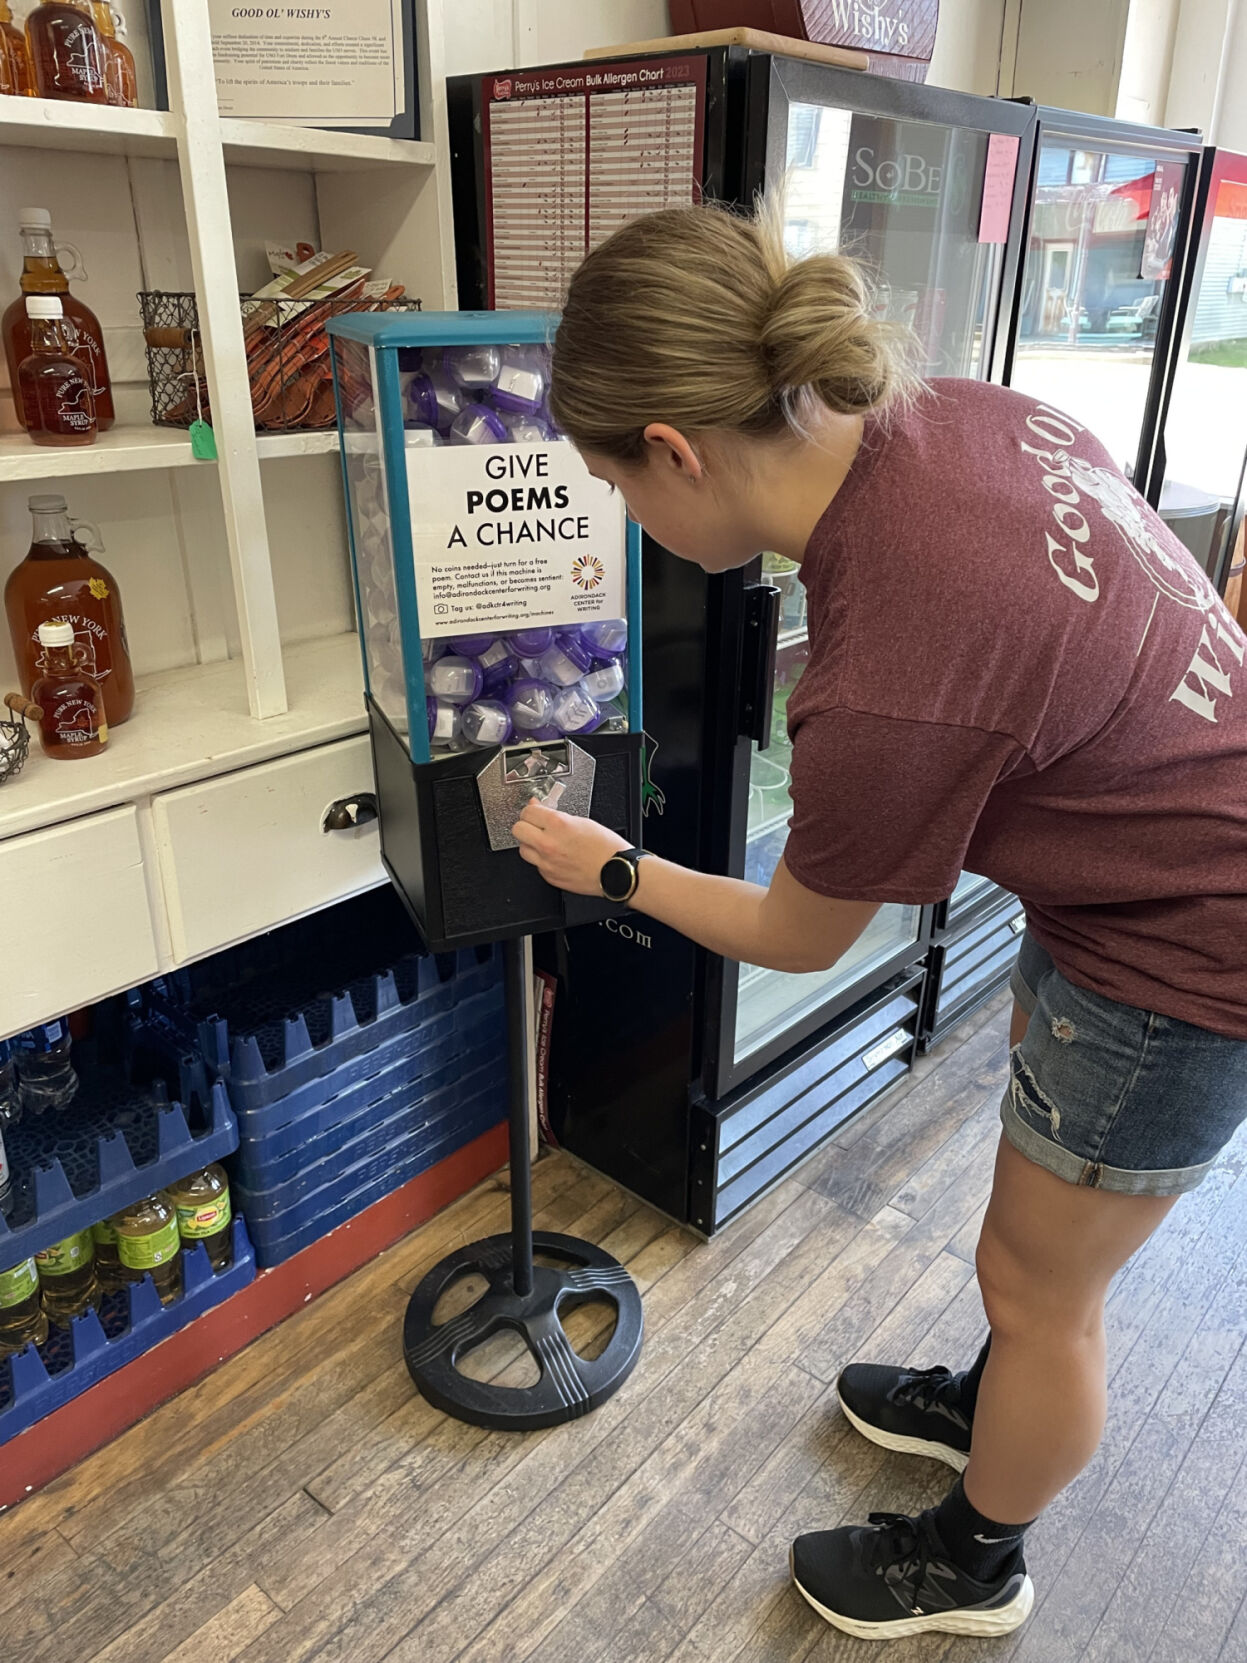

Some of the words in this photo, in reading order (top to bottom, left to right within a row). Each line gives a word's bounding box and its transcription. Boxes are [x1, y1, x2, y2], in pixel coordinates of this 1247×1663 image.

[231, 8, 263, 18] GOOD
[266, 8, 285, 18] OL'
[286, 8, 331, 19] WISHY'S
[515, 80, 540, 93] Perry's
[541, 79, 554, 89] Ice
[556, 76, 584, 88] Cream
[586, 74, 602, 86] Bulk
[602, 72, 637, 86] Allergen
[639, 68, 664, 81] Chart
[665, 65, 690, 79] 2023
[82, 331, 101, 357] YORK
[56, 382, 71, 398] PURE
[485, 453, 549, 479] GIVE
[466, 485, 569, 514] POEMS
[447, 524, 468, 549] A
[476, 516, 589, 546] CHANCE
[509, 568, 536, 576] machine
[456, 579, 498, 588] malfunctions,
[509, 576, 537, 584] becomes
[433, 584, 551, 599] info@adirondackcenterforwriting.org
[570, 592, 606, 600] ADIRONDACK
[451, 604, 463, 612] Tag
[573, 599, 595, 607] CENTER
[51, 614, 80, 624] NEW
[81, 616, 108, 641] YORK
[53, 703, 68, 719] PURE
[66, 699, 83, 707] NEW
[539, 1046, 547, 1073] Cream
